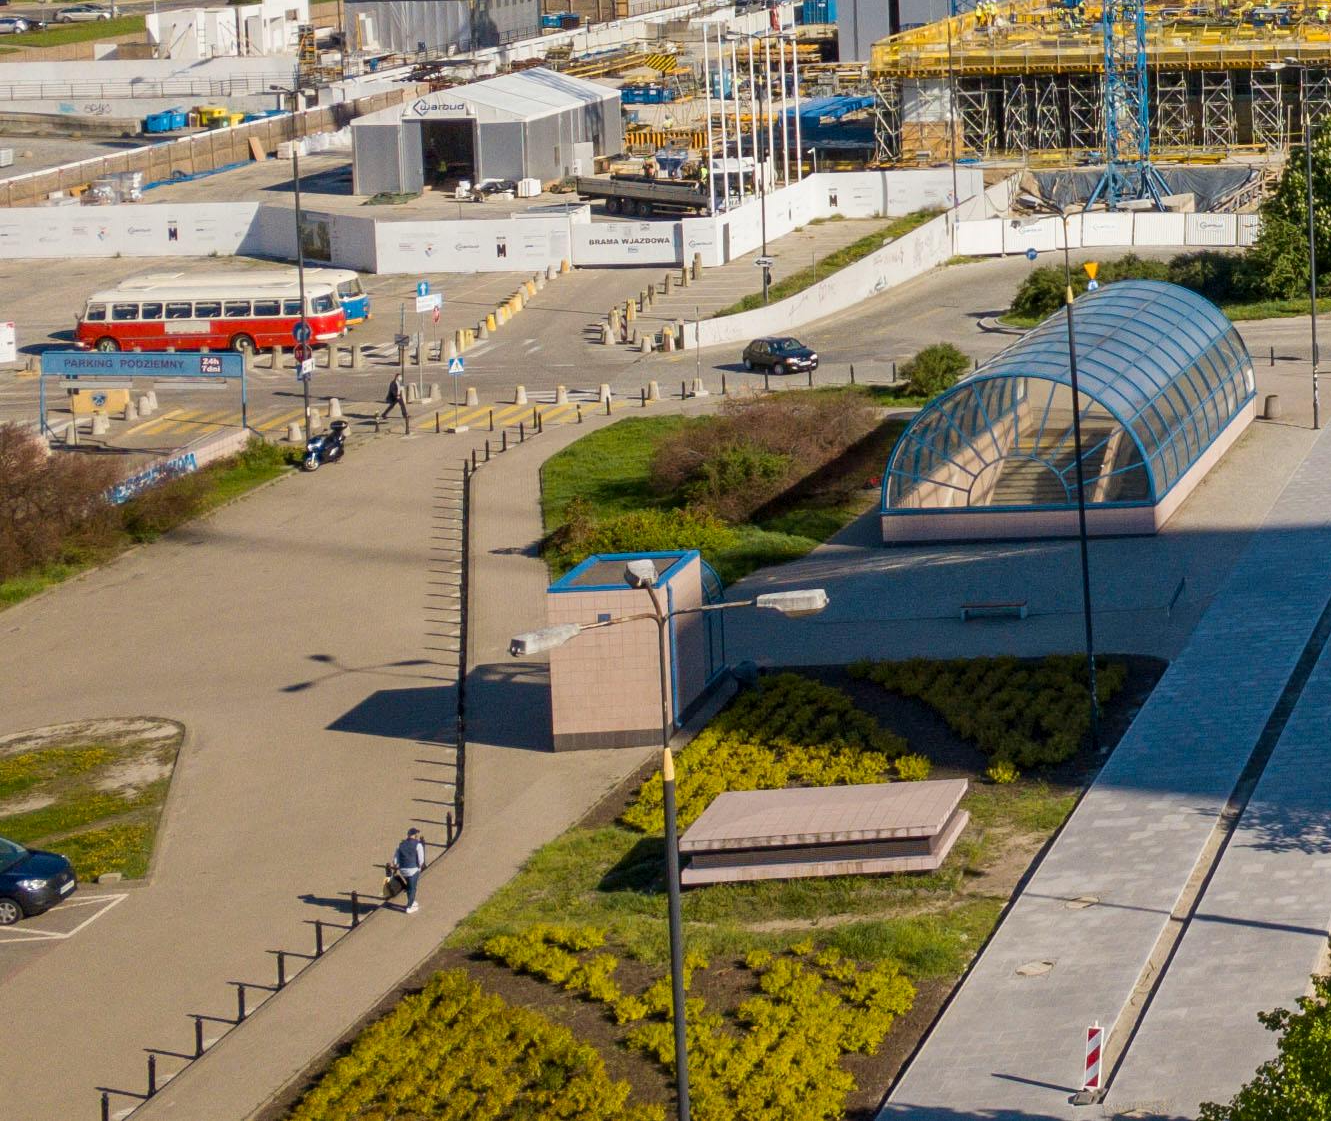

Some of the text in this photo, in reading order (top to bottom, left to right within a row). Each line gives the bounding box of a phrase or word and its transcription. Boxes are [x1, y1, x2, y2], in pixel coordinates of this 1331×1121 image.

[588, 237, 671, 246] BRAMA WJAZDOWA
[64, 357, 220, 369] PARKING PODZIEMNY 24h
